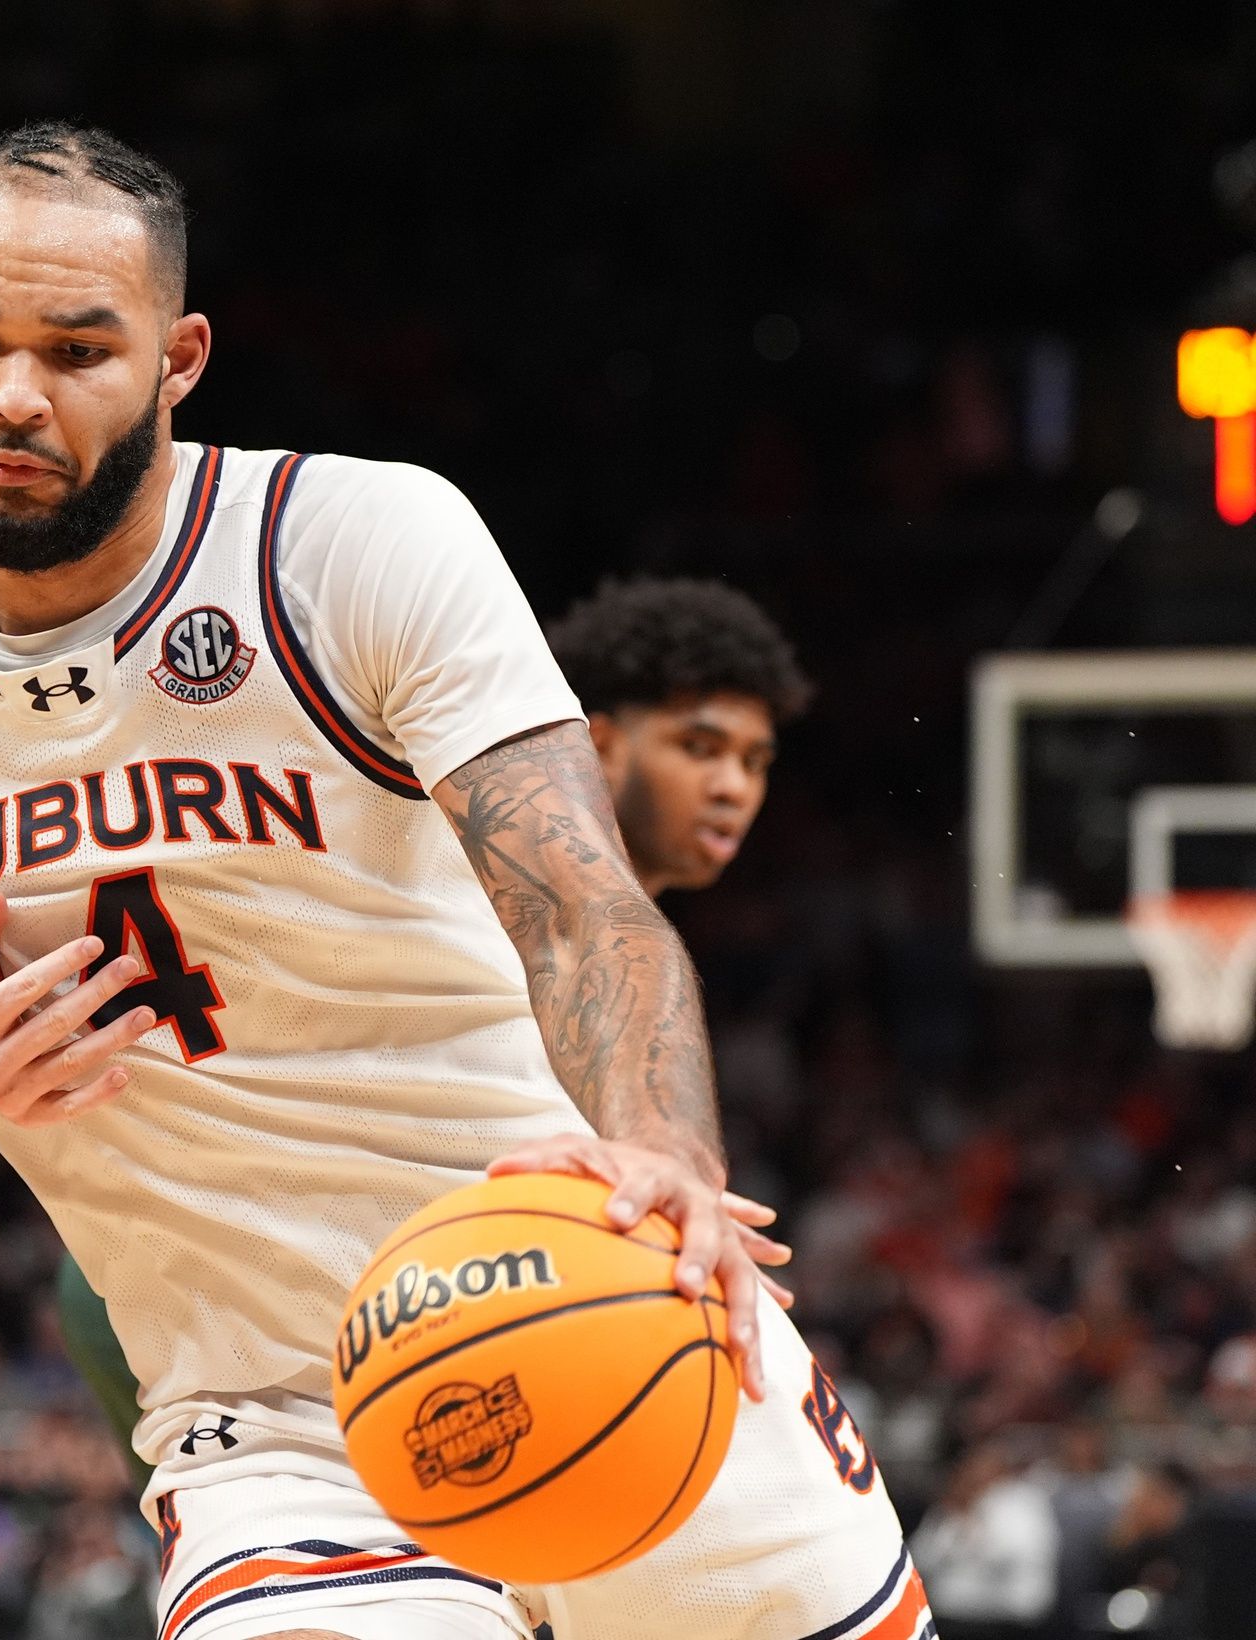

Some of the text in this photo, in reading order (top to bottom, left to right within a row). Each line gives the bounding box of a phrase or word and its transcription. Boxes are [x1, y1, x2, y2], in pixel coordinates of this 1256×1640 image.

[165, 664, 246, 701] GRADUATE
[168, 612, 233, 679] SEC
[81, 866, 227, 1064] 4
[338, 1248, 556, 1385] Wilson
